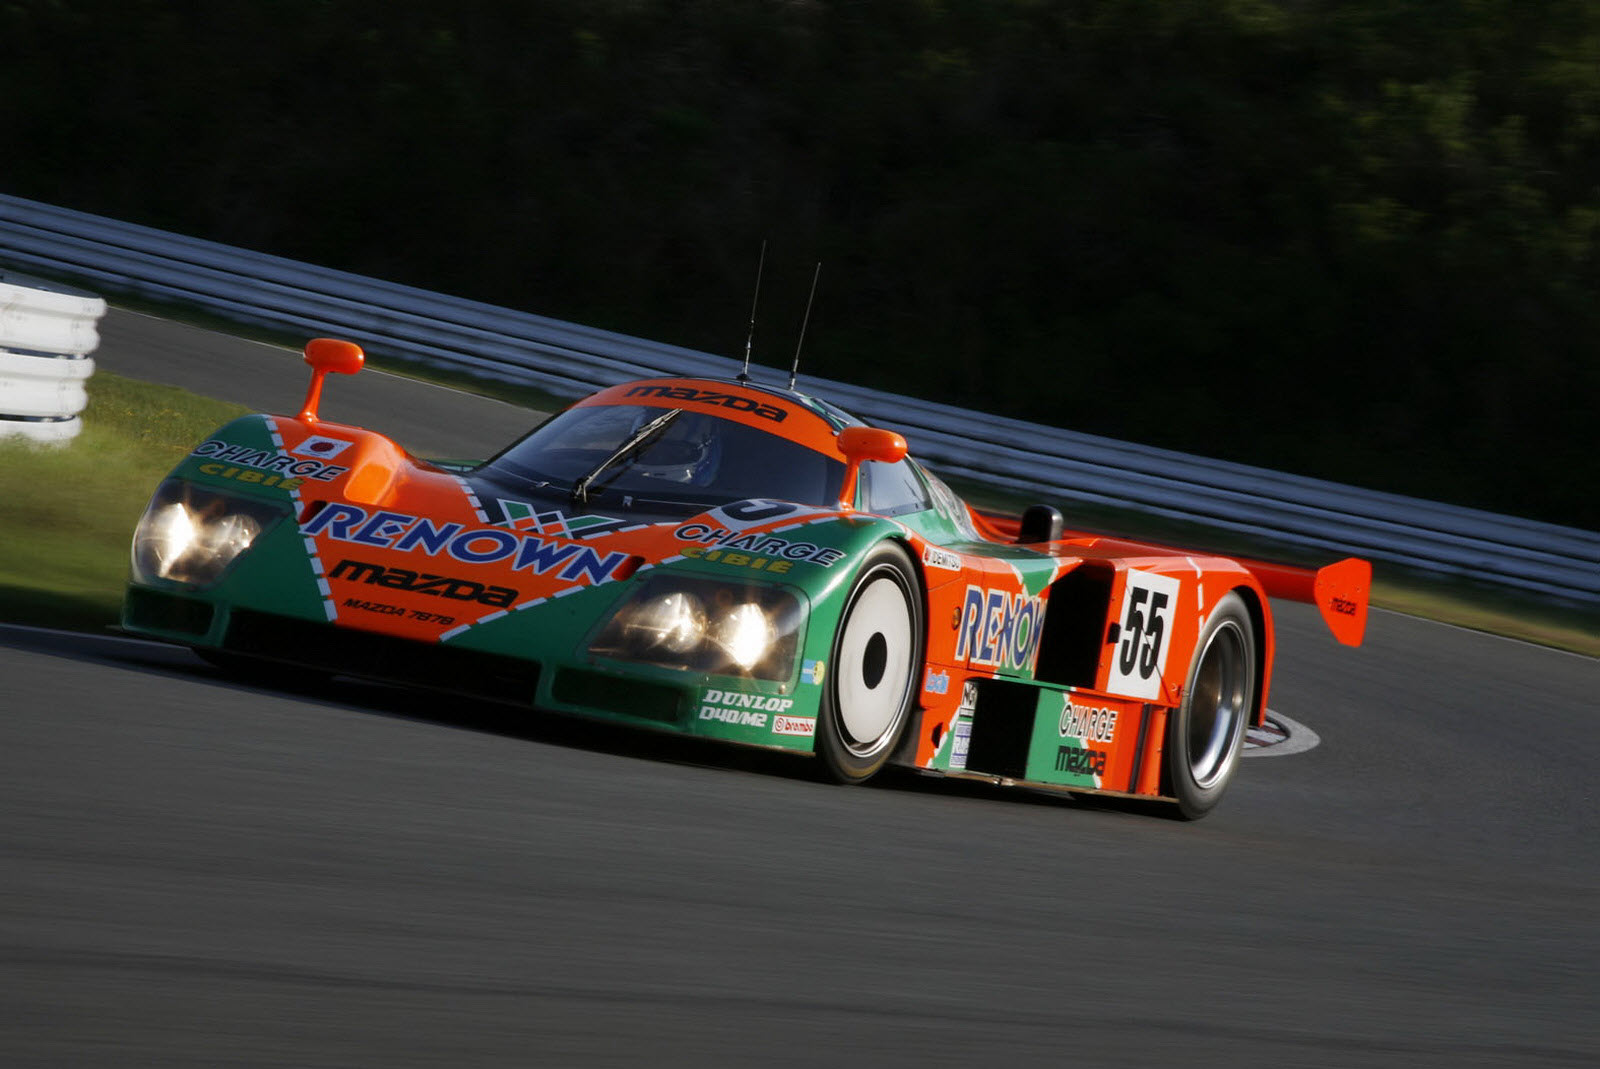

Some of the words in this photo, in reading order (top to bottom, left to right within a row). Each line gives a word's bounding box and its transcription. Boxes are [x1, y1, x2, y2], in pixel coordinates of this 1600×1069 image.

[624, 385, 788, 423] mazda
[190, 440, 350, 483] CHARGE
[300, 502, 629, 587] RENOWN
[674, 523, 847, 569] CHARGE
[328, 559, 519, 609] mazda
[342, 598, 404, 617] MAZDA
[1118, 586, 1169, 680] 55
[702, 689, 794, 713] DUNLOP
[1058, 702, 1119, 743] CHARGE
[1055, 745, 1107, 776] mazda
